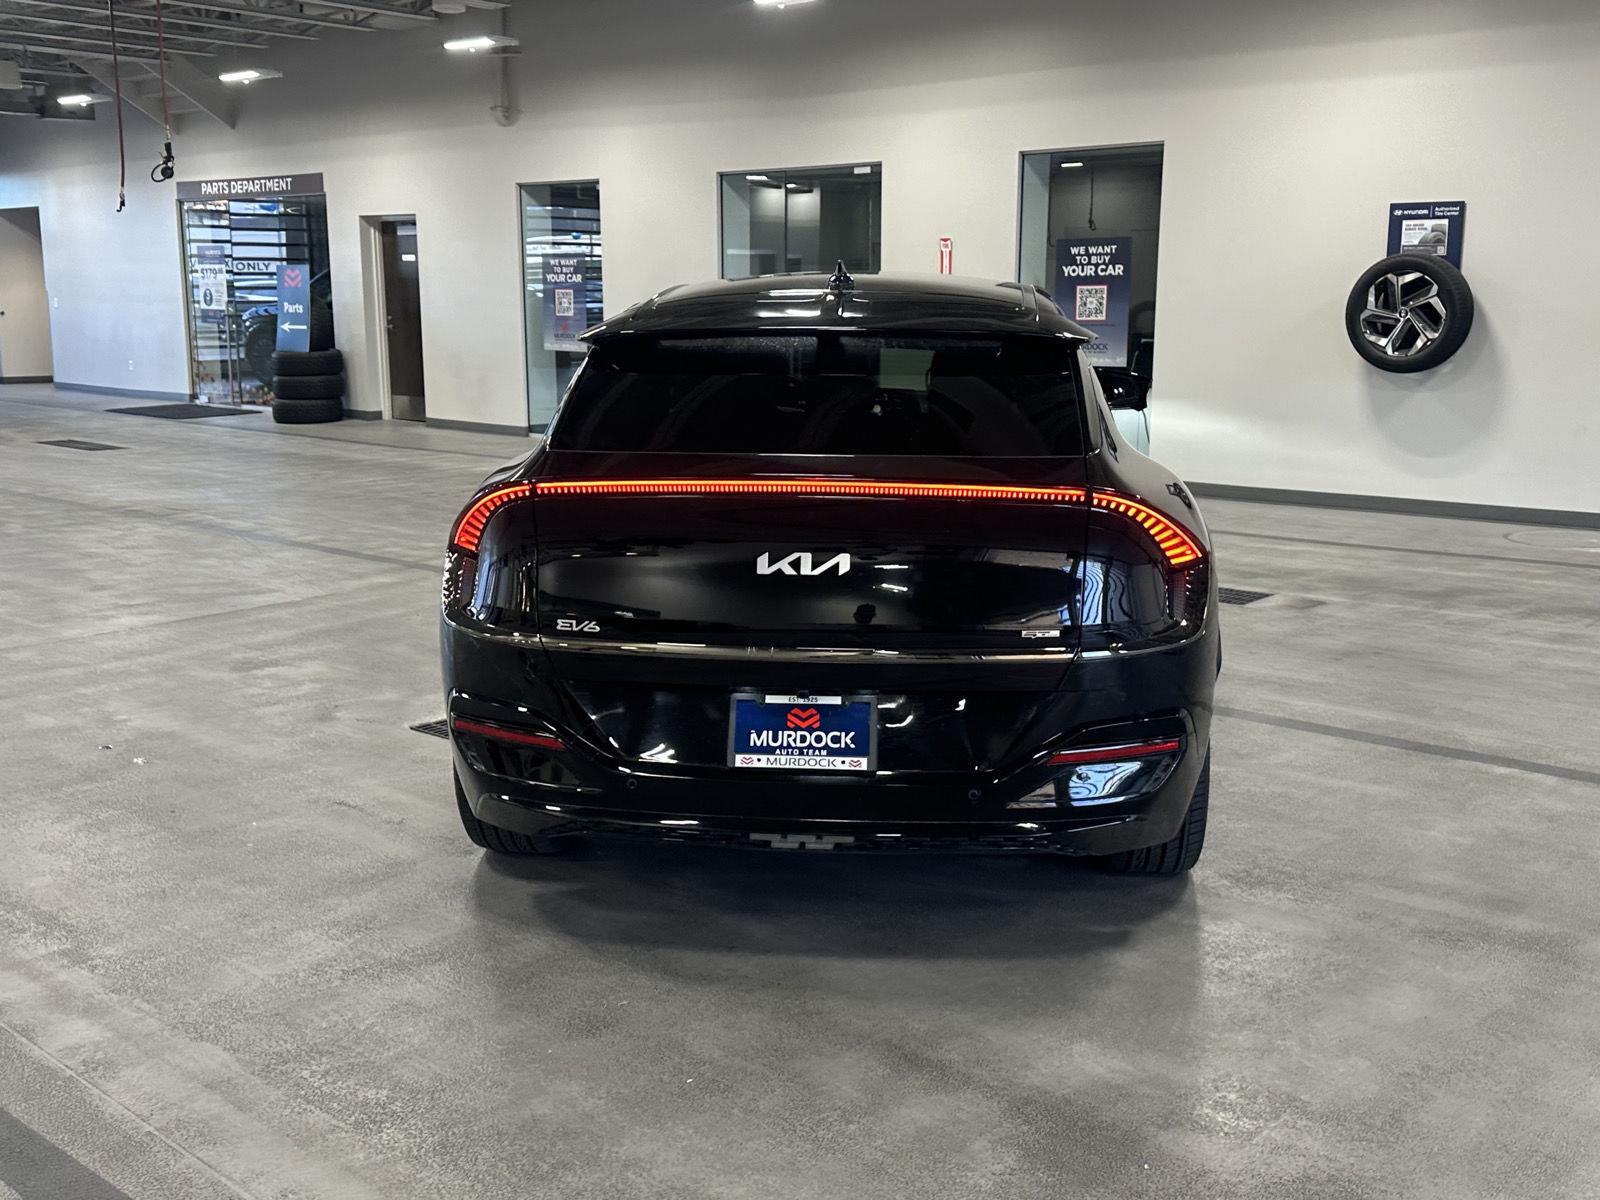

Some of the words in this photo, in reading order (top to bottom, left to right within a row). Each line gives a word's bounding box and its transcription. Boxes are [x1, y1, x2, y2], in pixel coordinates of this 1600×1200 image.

[201, 181, 229, 195] PARTS
[230, 178, 293, 194] DEPARTMENT
[1070, 246, 1086, 255] WE
[1088, 245, 1117, 254] WANT
[1076, 255, 1089, 264] TO
[1091, 255, 1110, 264] BUY
[235, 261, 271, 271] ONLY
[1062, 265, 1096, 277] YOUR
[1097, 264, 1124, 276] CAR
[546, 273, 565, 282] YOUR
[567, 273, 582, 282] CAR
[283, 302, 303, 313] Parts
[756, 552, 851, 576] KIA
[556, 619, 600, 632] EV6
[750, 730, 856, 748] MURDOCK
[766, 757, 837, 768] MURDOCK
